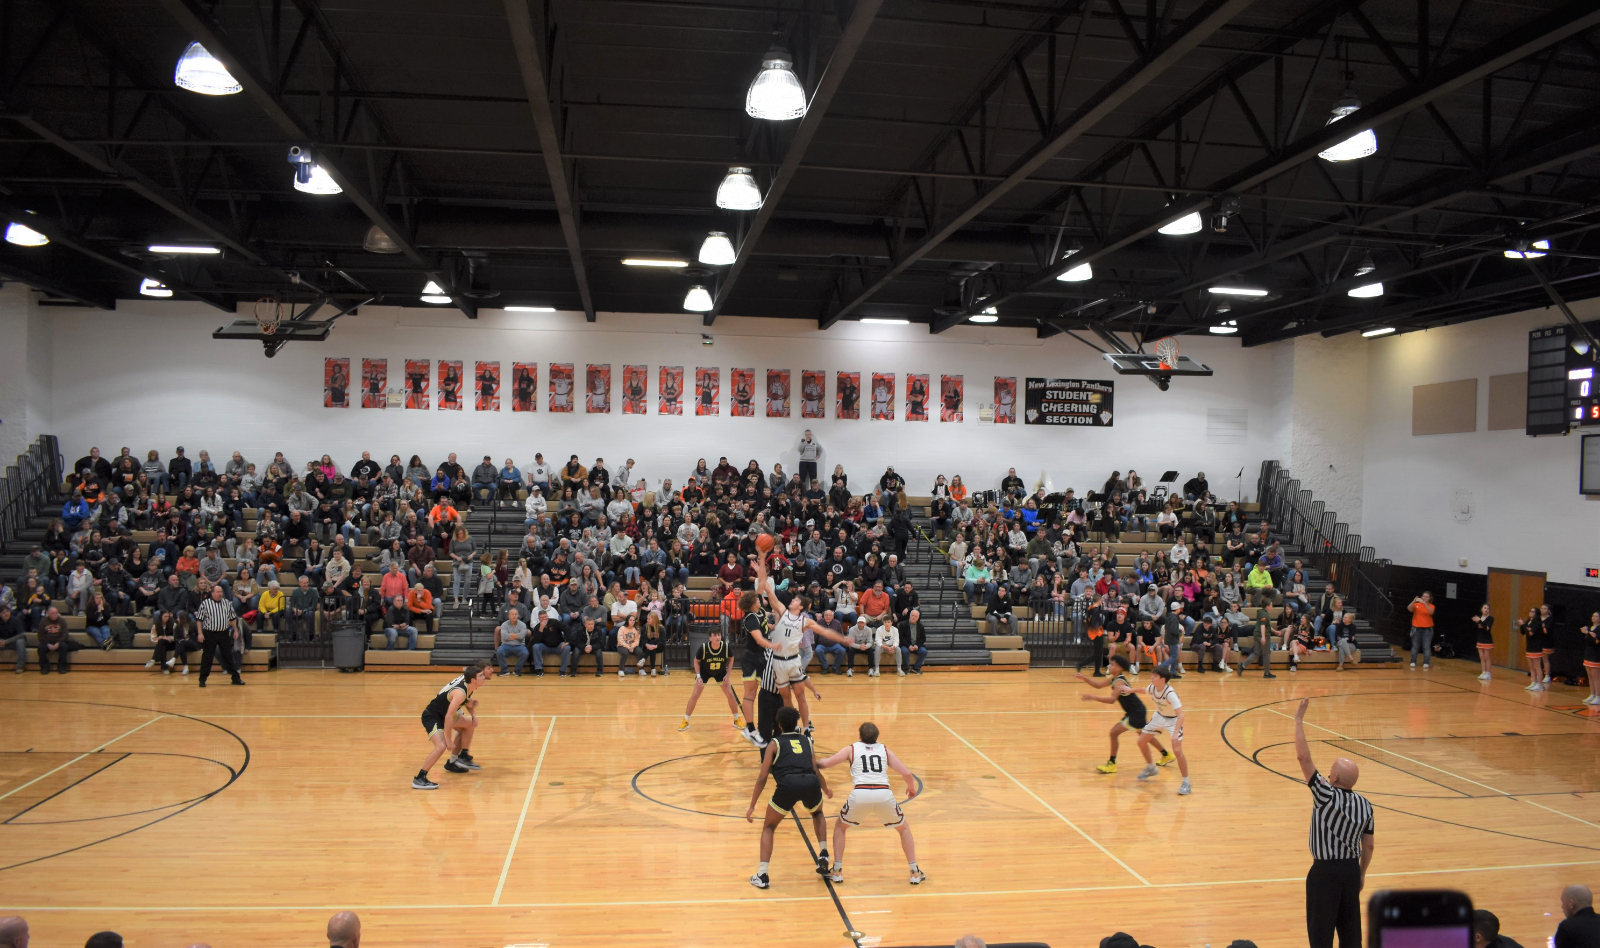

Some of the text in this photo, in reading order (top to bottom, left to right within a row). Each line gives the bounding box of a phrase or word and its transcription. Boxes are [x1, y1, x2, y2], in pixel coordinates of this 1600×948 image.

[1028, 380, 1112, 393] New Lexington Panthers
[1046, 391, 1093, 400] STUDENT
[1041, 403, 1097, 414] CHEERING
[1046, 416, 1093, 424] SECTION
[785, 628, 791, 637] 11
[710, 662, 721, 670] 23
[789, 740, 803, 754] 5
[860, 754, 883, 773] 10
